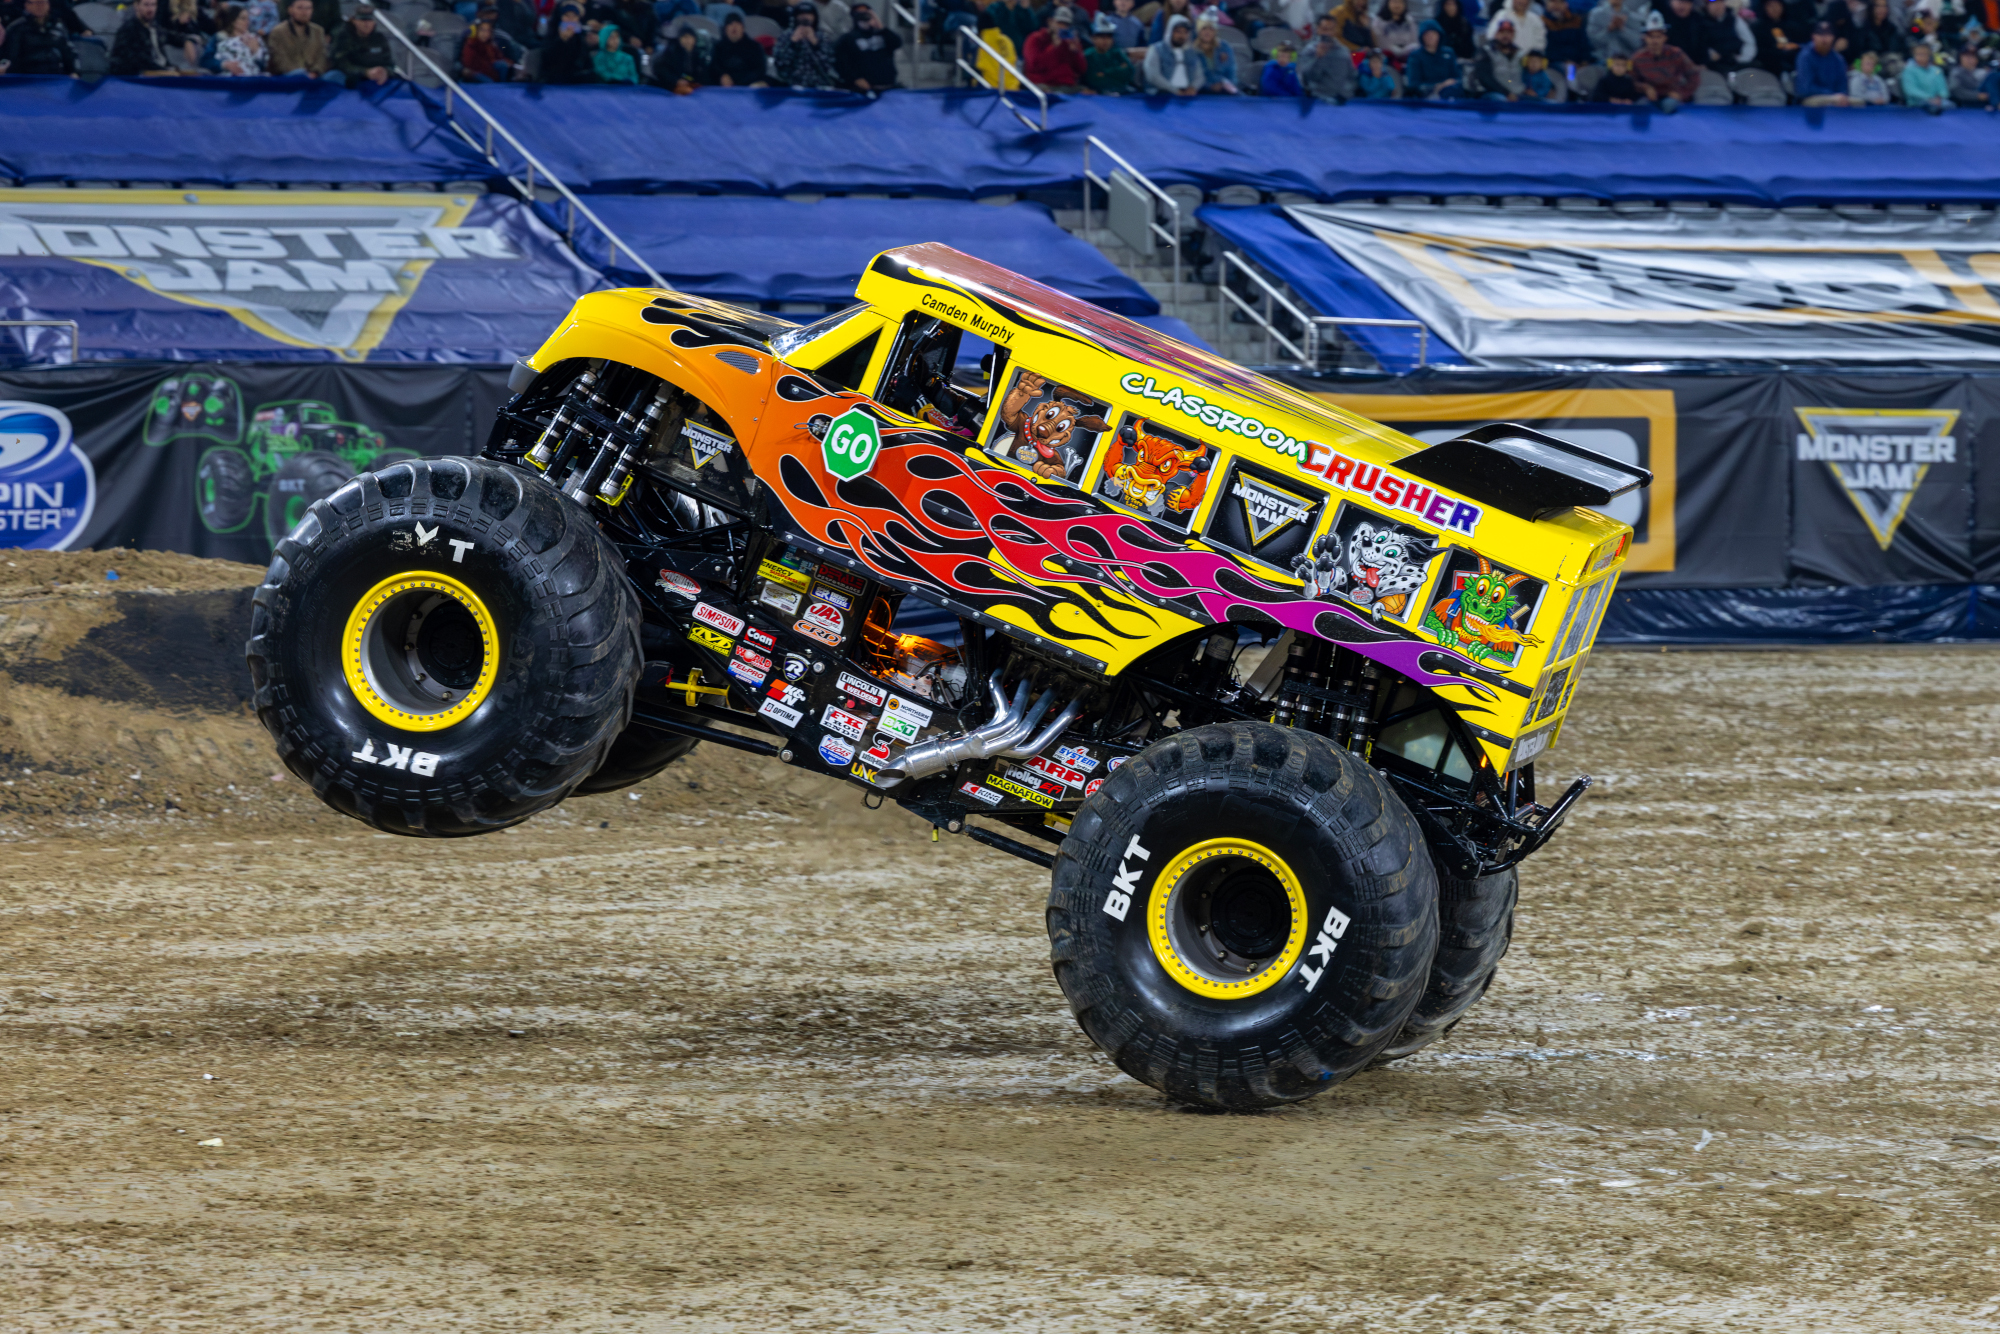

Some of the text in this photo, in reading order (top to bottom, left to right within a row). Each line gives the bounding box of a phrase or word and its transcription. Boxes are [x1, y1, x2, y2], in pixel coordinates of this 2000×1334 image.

[143, 259, 398, 292] JAM
[921, 293, 1015, 344] Camden Murphy
[681, 426, 733, 454] MONSTER
[692, 442, 716, 456] JAM
[831, 424, 872, 464] GO
[1797, 433, 1956, 463] MONSTER
[1120, 373, 1482, 537] CLASSROOM CRUSHER
[1846, 463, 1913, 490] JAM
[1232, 483, 1310, 524] MONSTER
[1248, 505, 1283, 526] JAM
[697, 606, 740, 631] SIMPSON
[810, 604, 841, 625] JAZ
[747, 627, 773, 646] Coan
[735, 645, 772, 668] WORLD
[841, 674, 879, 696] LINCOLN
[846, 686, 879, 704] WELDERS
[772, 705, 797, 722] OPTIMA
[900, 704, 930, 720] NORTHERN
[823, 721, 858, 740] ENDS
[833, 719, 860, 735] ROD
[882, 715, 917, 737] BKT
[352, 738, 440, 778] BKT
[824, 743, 851, 757] LUCAS
[1059, 747, 1097, 767] SYSTEM
[1007, 765, 1042, 790] Holley
[1027, 756, 1084, 785] ARP
[976, 788, 1001, 803] KING
[987, 775, 1052, 807] MAGNAFLOW
[1102, 833, 1151, 922] BKT
[1299, 906, 1351, 993] BKT
